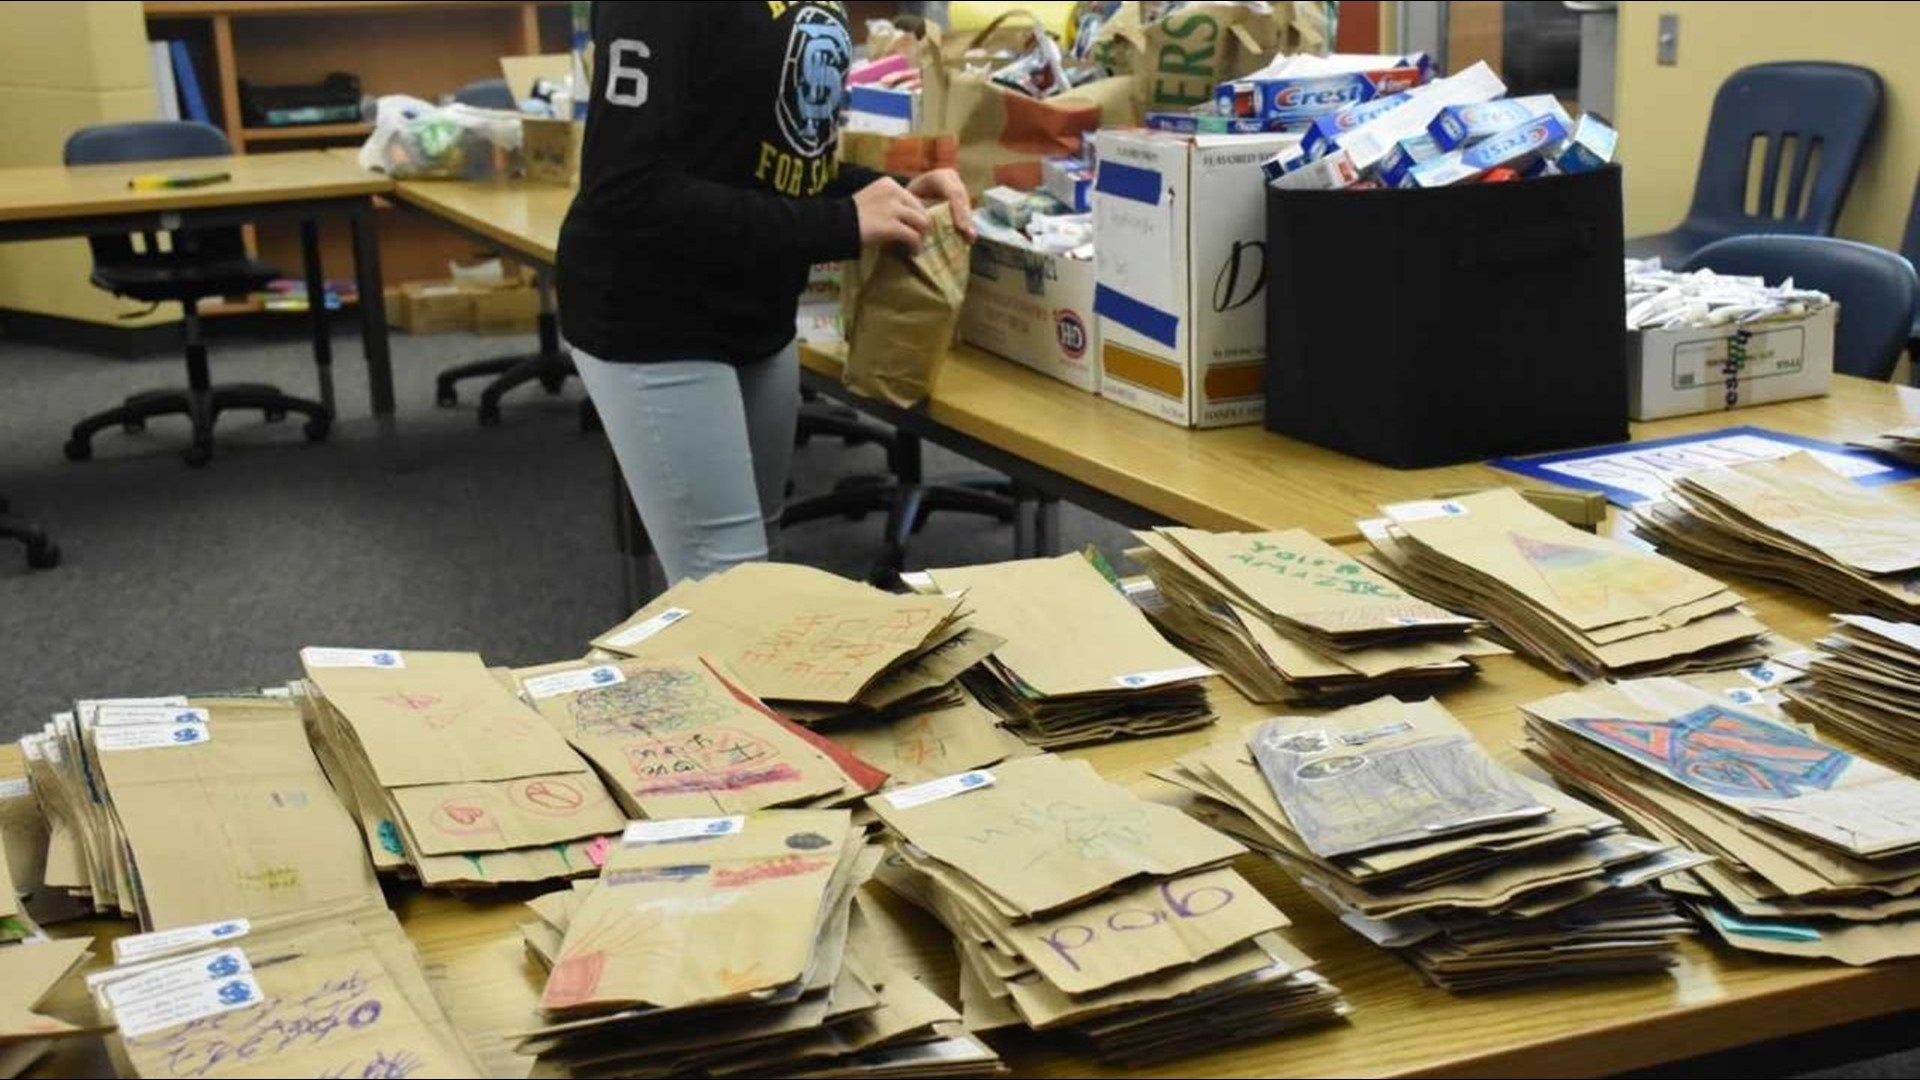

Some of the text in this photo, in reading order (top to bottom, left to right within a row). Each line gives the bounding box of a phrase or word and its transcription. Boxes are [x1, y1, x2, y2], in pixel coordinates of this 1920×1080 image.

[605, 38, 651, 108] 6
[1154, 14, 1219, 105] ERS
[755, 140, 804, 197] FOR
